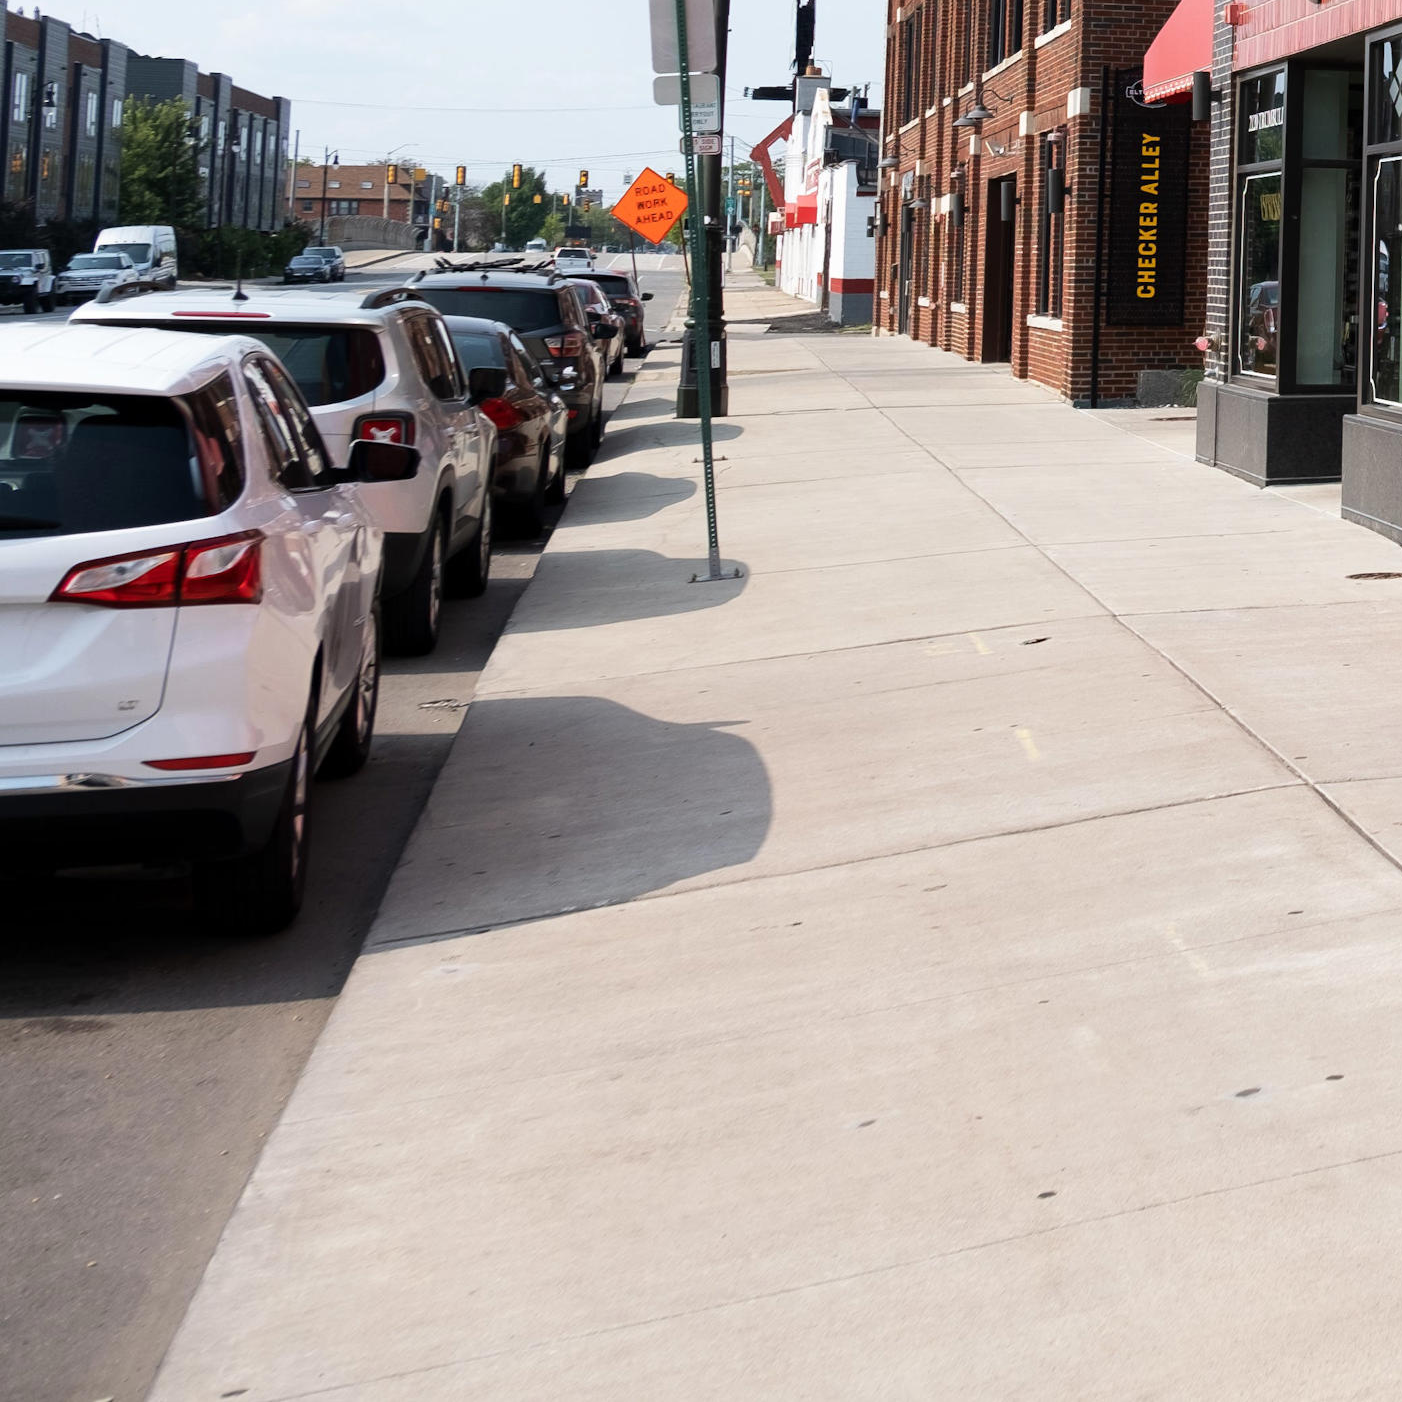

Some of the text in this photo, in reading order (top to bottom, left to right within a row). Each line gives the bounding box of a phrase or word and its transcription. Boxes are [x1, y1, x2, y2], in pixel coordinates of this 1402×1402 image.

[635, 184, 666, 196] ROAD
[637, 198, 668, 210] WORK
[635, 210, 674, 224] AHEAD
[1136, 133, 1161, 299] CHECKER ALLEY
